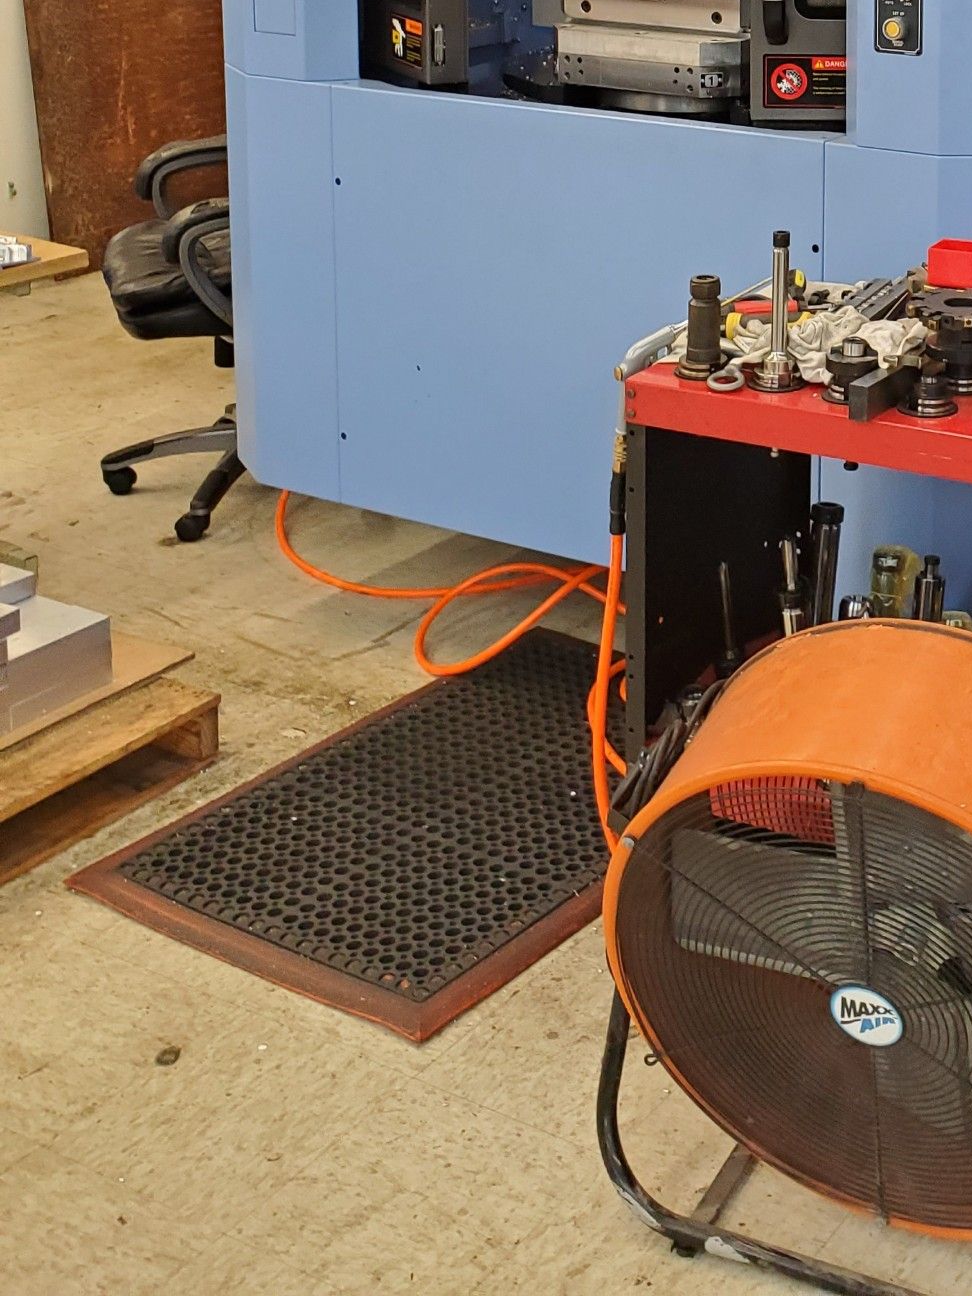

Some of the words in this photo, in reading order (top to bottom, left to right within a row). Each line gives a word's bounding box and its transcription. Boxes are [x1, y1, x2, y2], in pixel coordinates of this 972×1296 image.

[824, 60, 848, 68] DANG
[708, 75, 714, 86] 1
[840, 995, 894, 1019] MAXX
[859, 1016, 896, 1034] AIR
